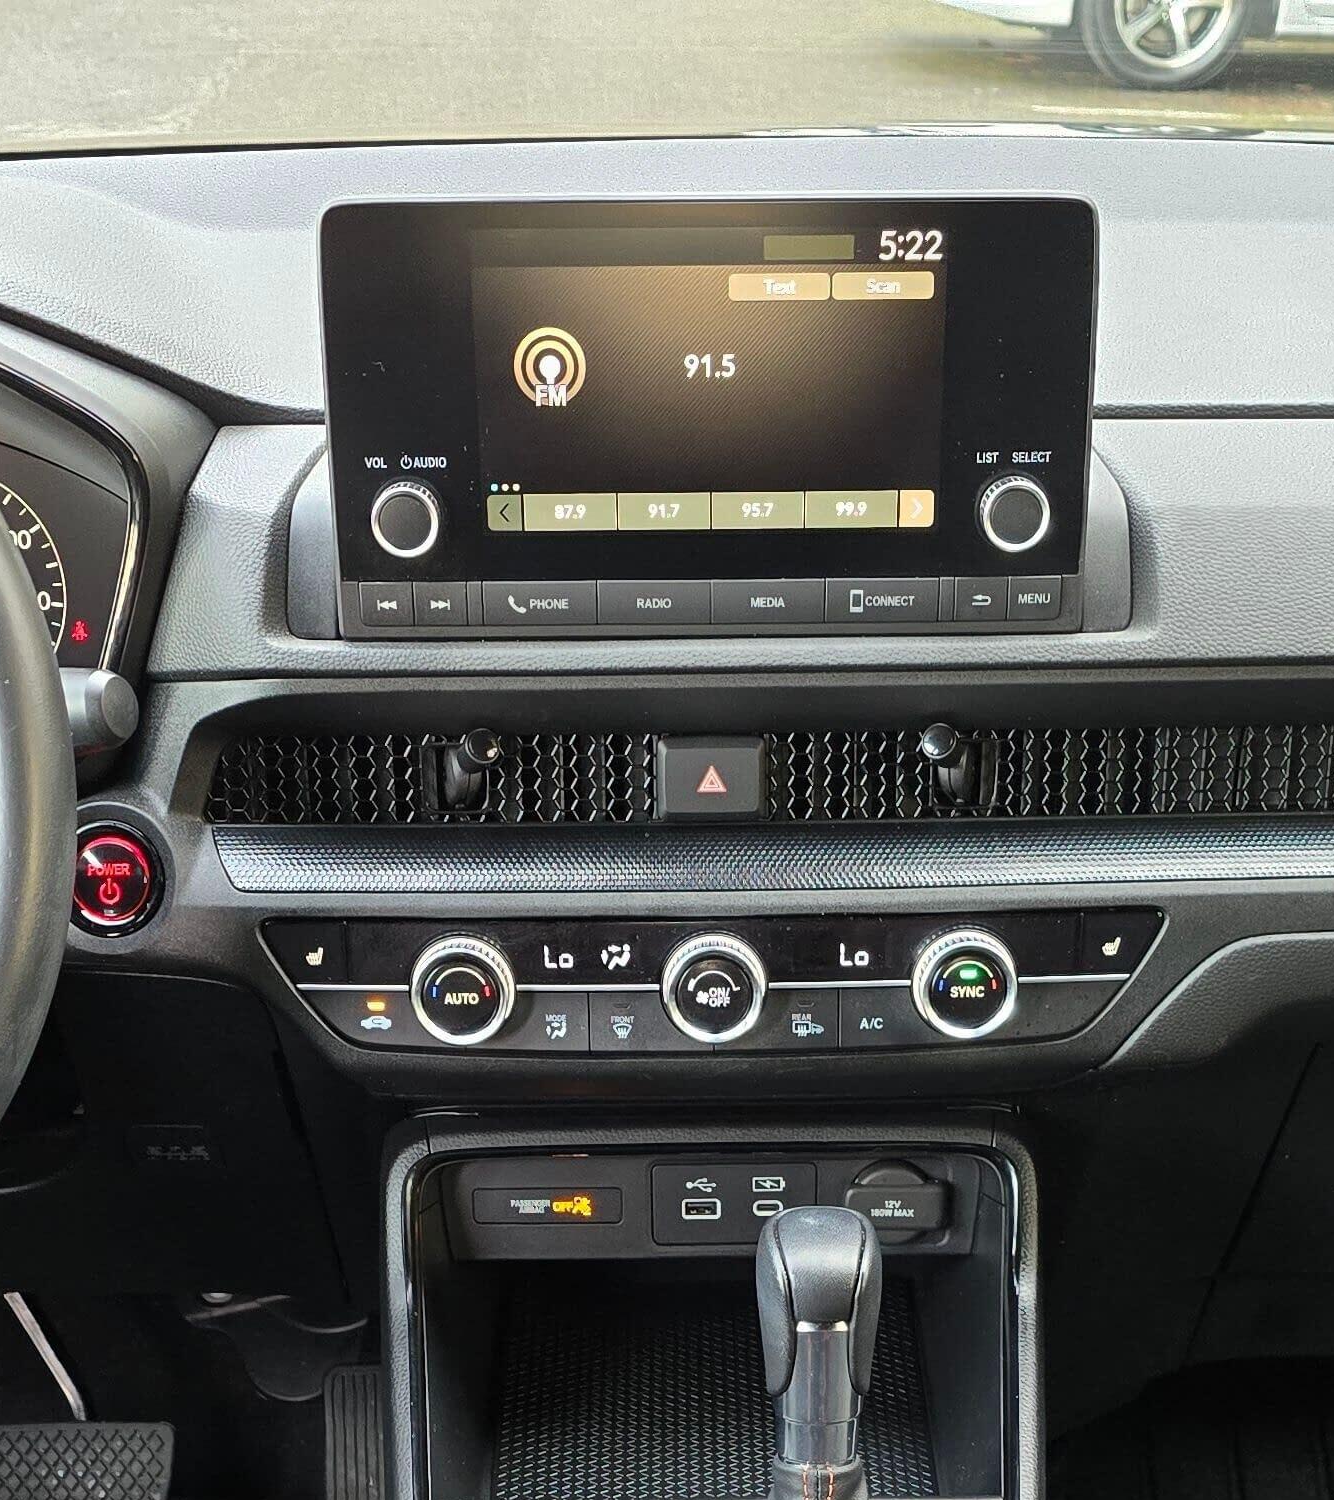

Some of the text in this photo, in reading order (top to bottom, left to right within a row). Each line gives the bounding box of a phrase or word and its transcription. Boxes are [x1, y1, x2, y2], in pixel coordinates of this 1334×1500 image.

[878, 230, 943, 261] 5:22
[763, 278, 796, 295] Text
[866, 278, 901, 294] Scan
[683, 353, 736, 378] 91.5
[535, 384, 567, 407] FM
[364, 456, 388, 469] VOL
[413, 456, 447, 469] AUDIO
[976, 451, 1052, 463] LIST SELECT
[554, 504, 587, 520] 87.9
[648, 503, 680, 519] 91.7
[742, 502, 774, 518] 95.7
[835, 501, 867, 517] 99.9
[529, 598, 569, 610] PHONE
[636, 598, 672, 610] RADIO
[750, 597, 785, 609] MEDIA
[865, 595, 915, 608] CONNECT
[1017, 593, 1051, 605] MENU
[87, 863, 131, 877] POWER
[543, 944, 574, 970] Lo
[839, 942, 870, 967] Lo
[950, 985, 985, 999] SYNC
[443, 992, 480, 1006] AUTO
[708, 997, 731, 1008] OFF
[545, 1014, 567, 1023] MODE
[610, 1015, 635, 1025] FRONT
[859, 1017, 884, 1030] A/C
[884, 1200, 902, 1209] 12V
[893, 1208, 915, 1218] MAX
